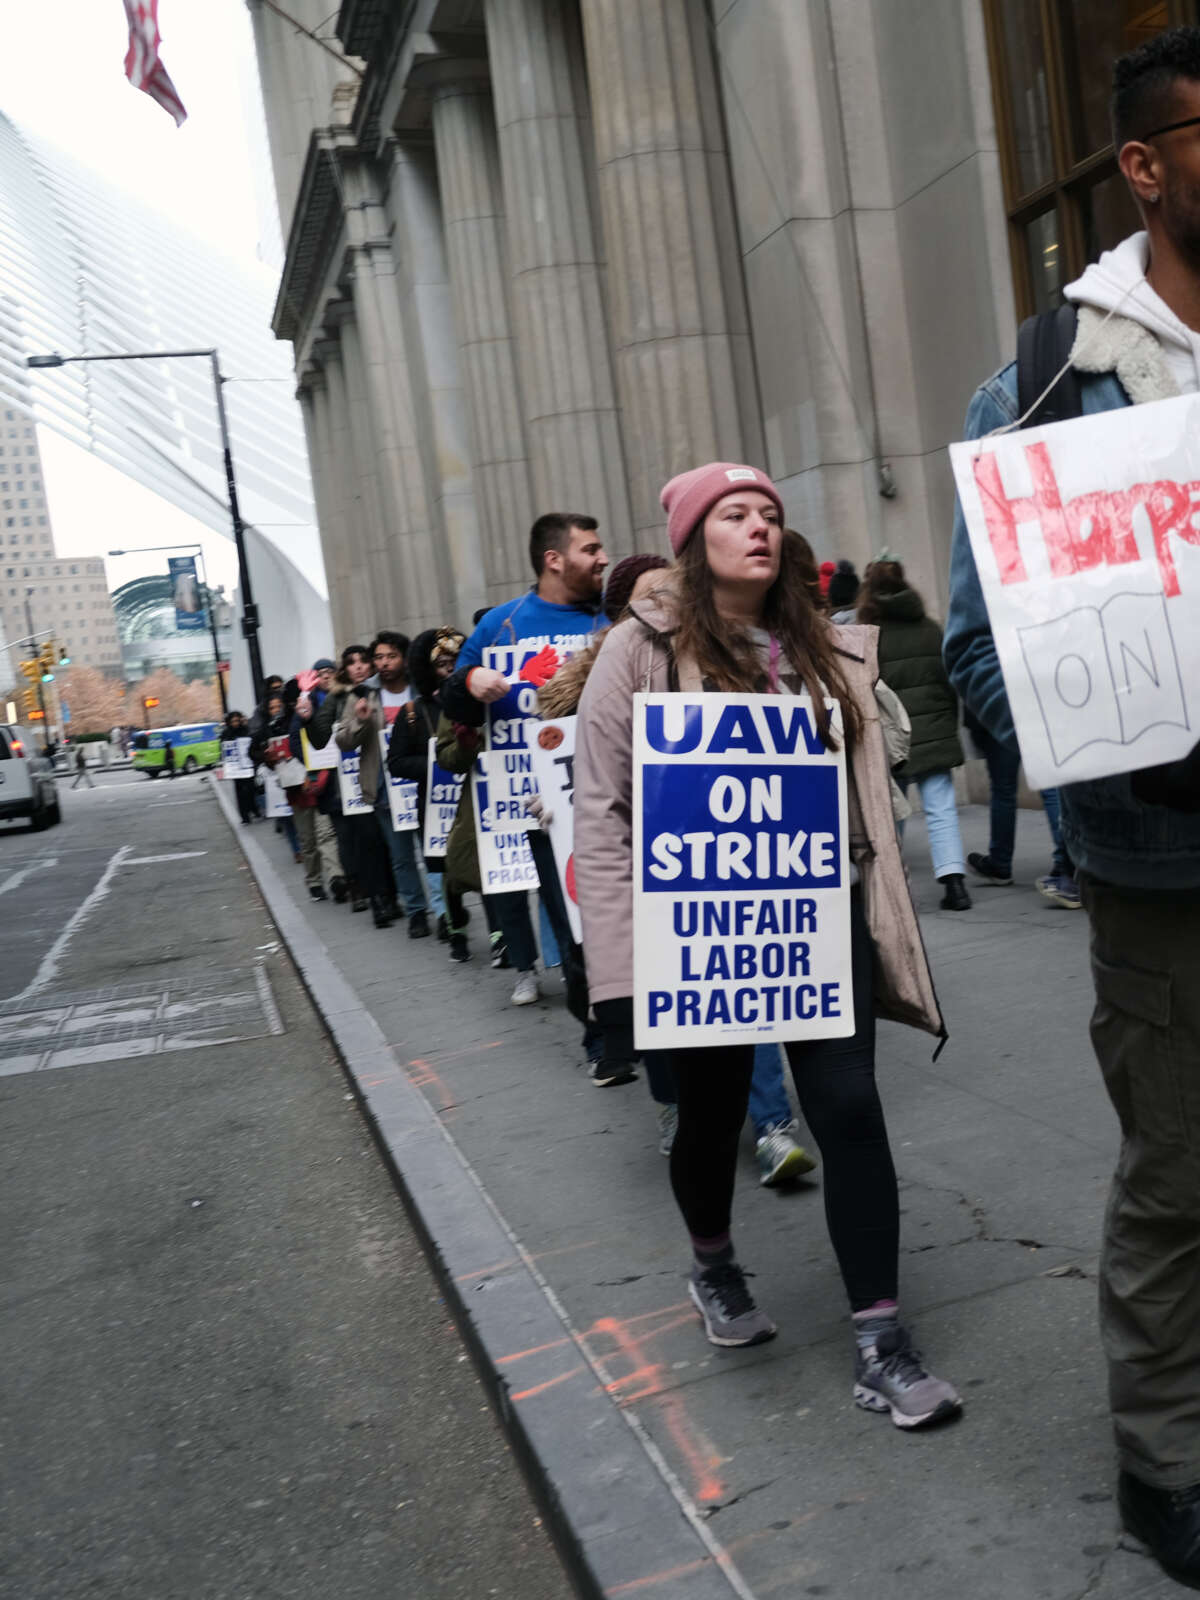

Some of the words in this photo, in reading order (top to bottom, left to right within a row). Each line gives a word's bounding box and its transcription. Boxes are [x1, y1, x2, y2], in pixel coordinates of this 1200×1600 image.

[1054, 628, 1161, 708] ON
[645, 704, 835, 754] UAW
[708, 774, 783, 823] ON
[648, 829, 836, 880] STRIKE
[673, 898, 817, 938] UNFAIR
[681, 942, 811, 982] LABOR
[648, 982, 842, 1027] PRACTICE
